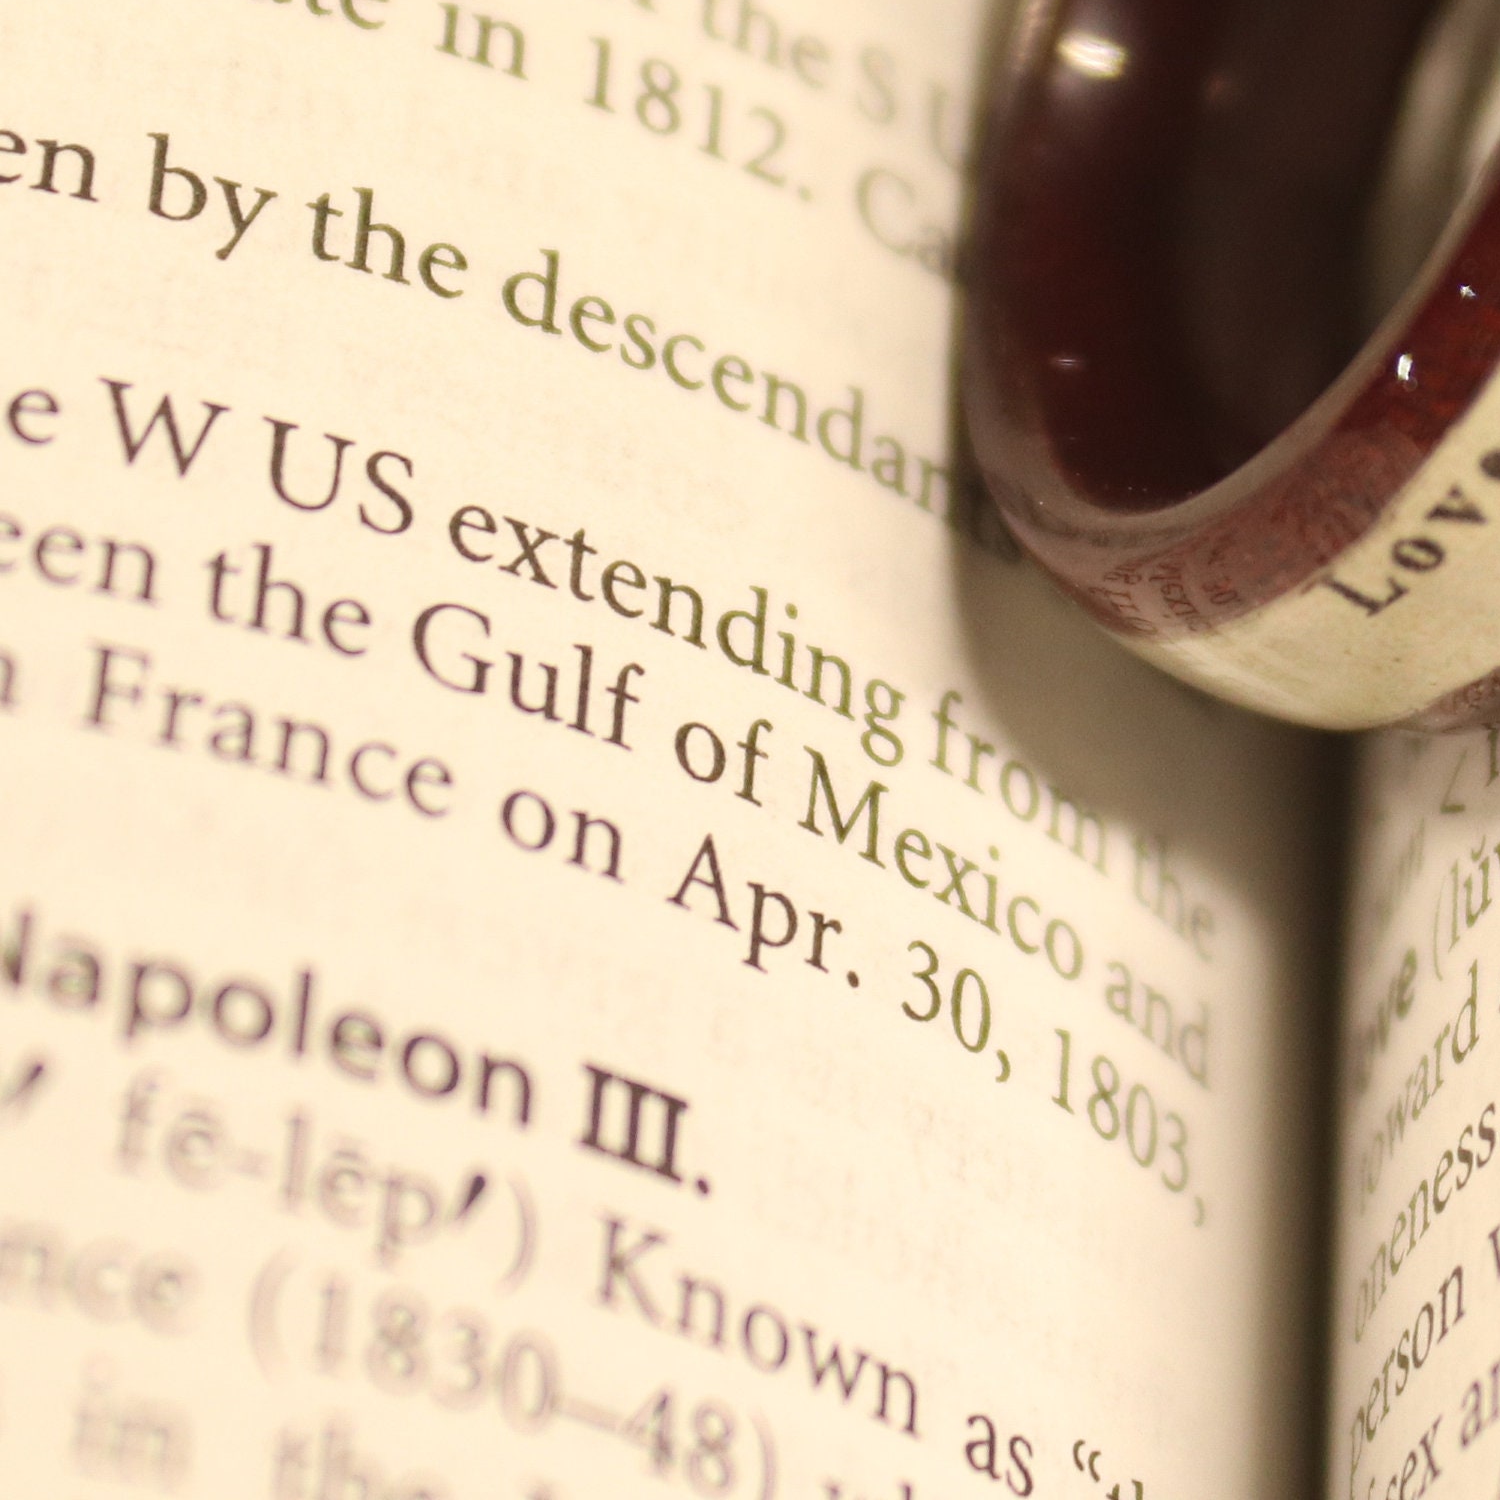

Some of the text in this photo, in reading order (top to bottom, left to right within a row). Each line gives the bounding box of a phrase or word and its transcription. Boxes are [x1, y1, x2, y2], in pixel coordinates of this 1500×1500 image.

[582, 37, 816, 204] 1812.
[147, 133, 278, 261] by
[306, 188, 469, 300] the
[501, 250, 970, 530] descendan
[98, 377, 230, 478] W
[263, 417, 416, 535] US
[448, 504, 909, 766] extending
[931, 690, 1112, 878] from
[82, 641, 1208, 1228] France on Apr. 30, 1803,
[207, 544, 372, 657] the
[412, 603, 646, 750] Gulf
[674, 720, 773, 808] of
[799, 746, 1083, 981] Mexico
[1105, 958, 1212, 1090] and
[578, 1064, 711, 1195] III.
[597, 1209, 920, 1438] Known
[964, 1414, 1034, 1498] as
[1349, 1265, 1465, 1500] person
